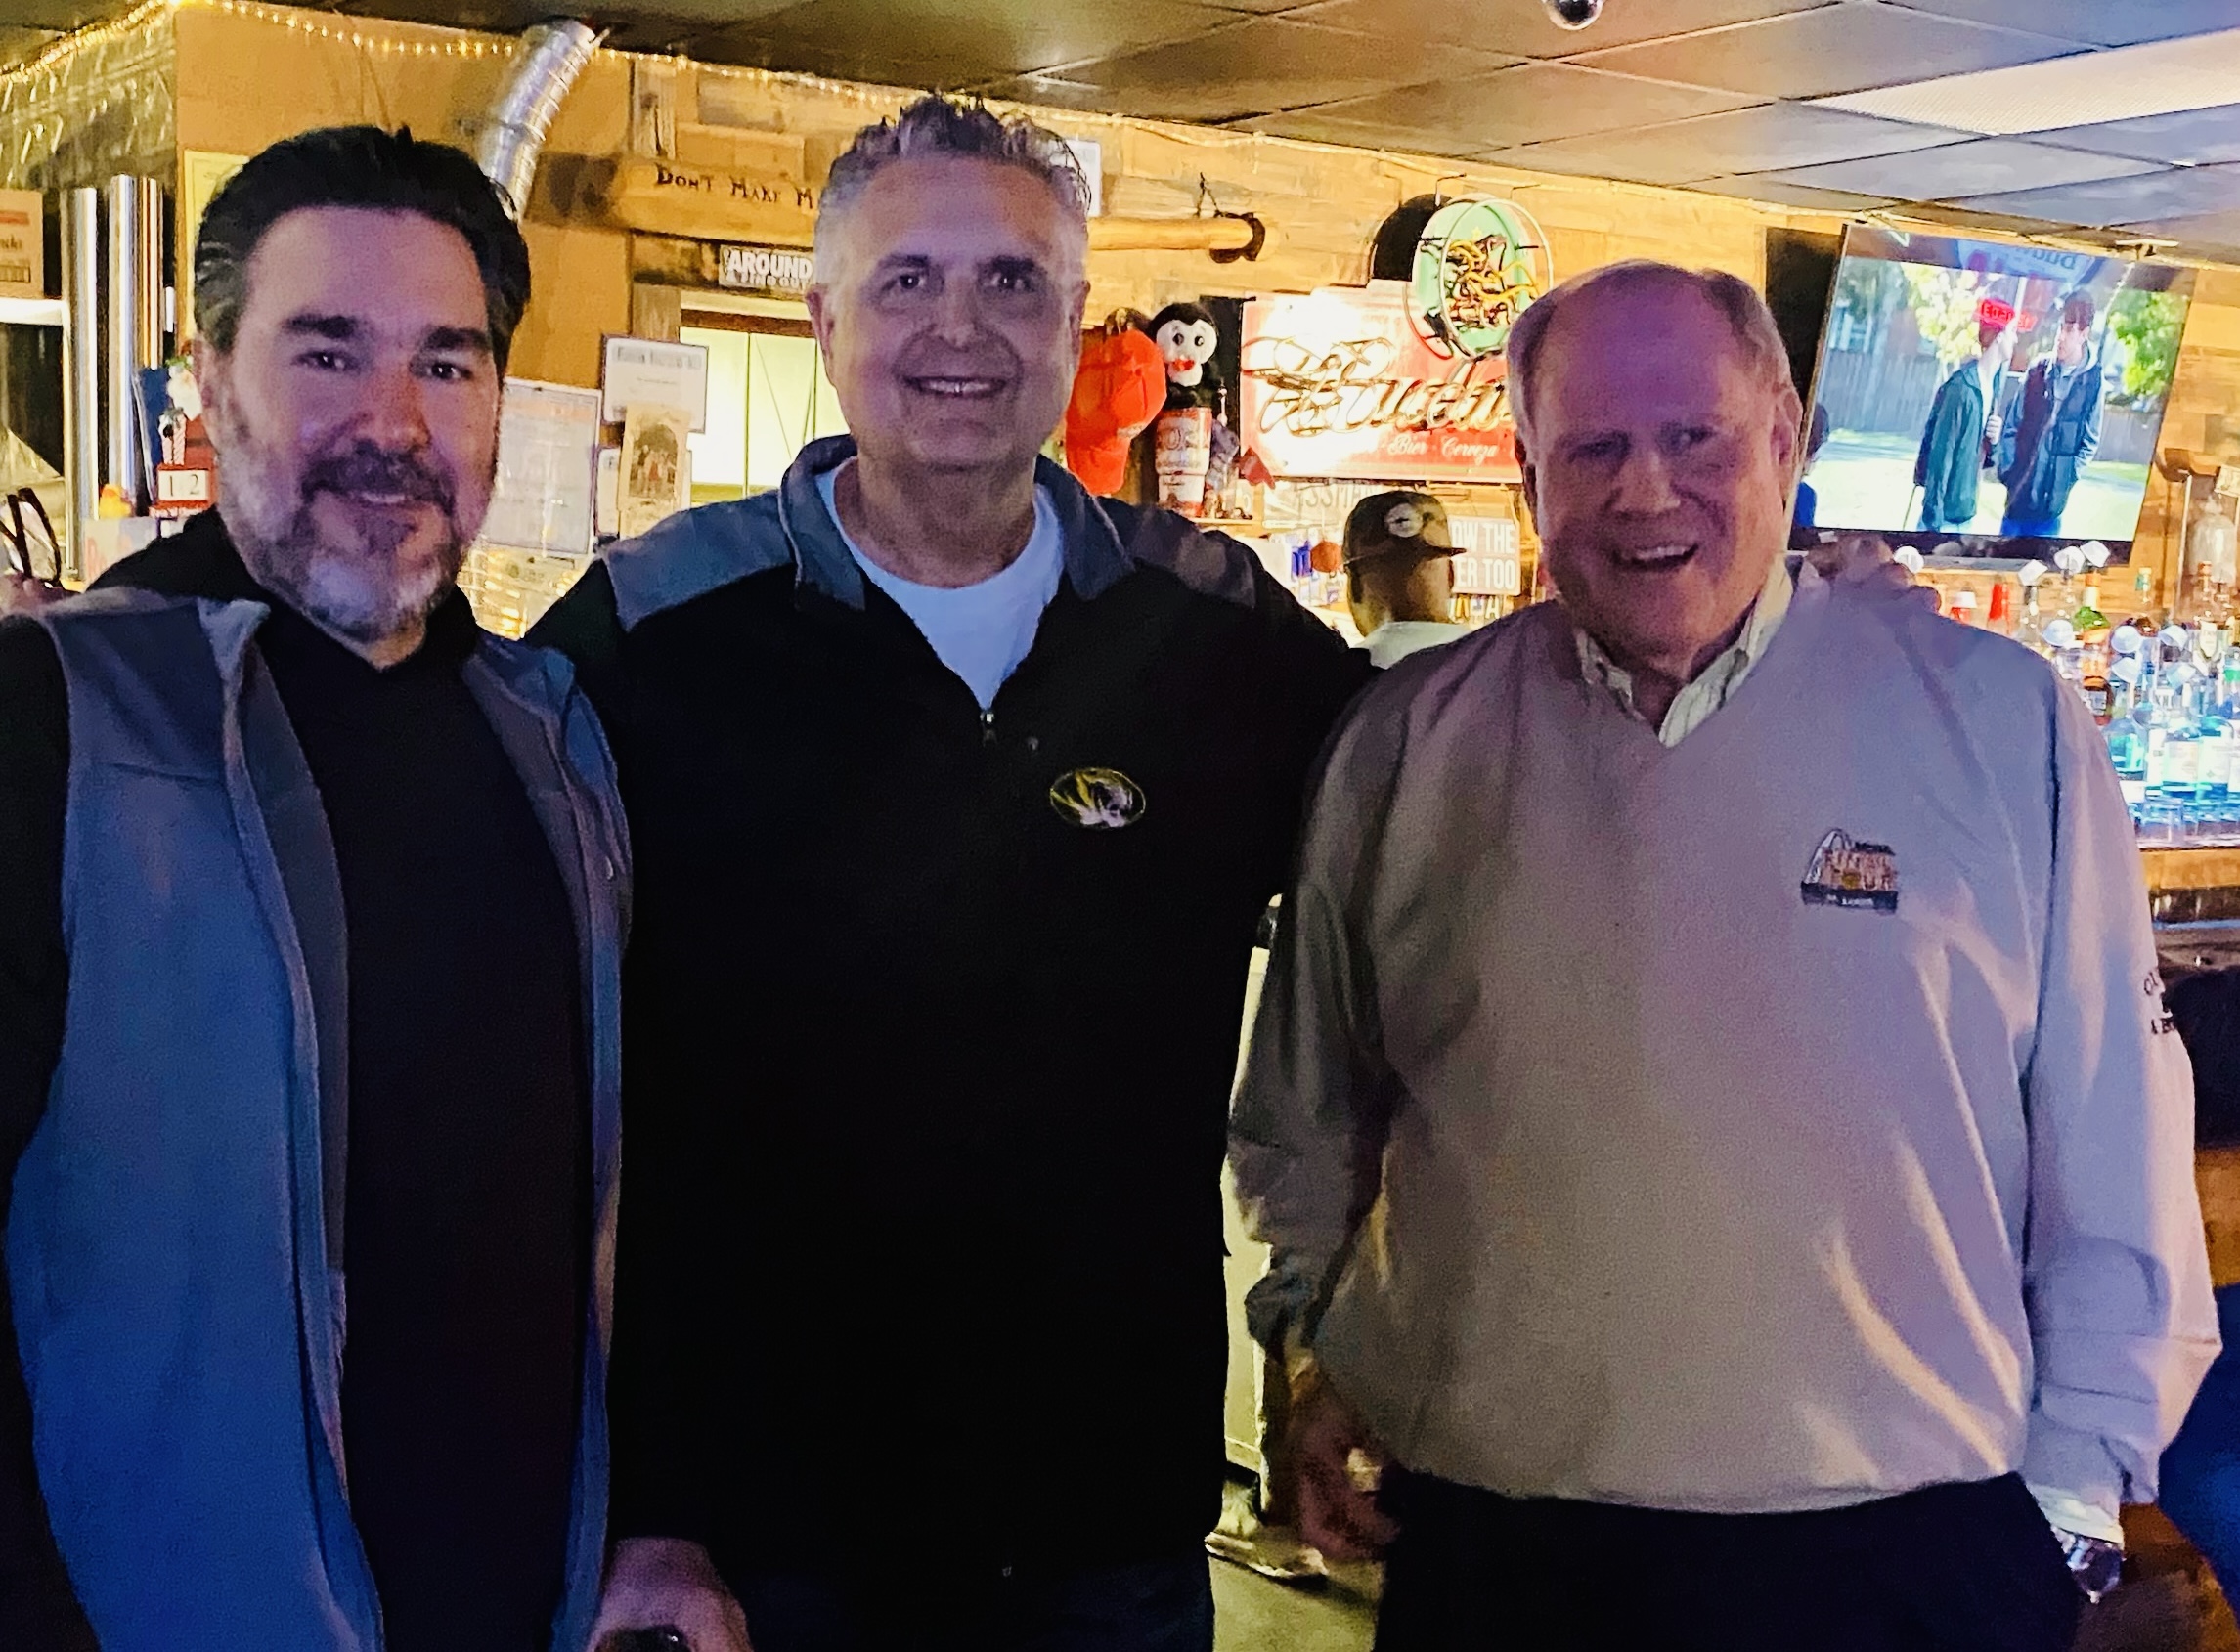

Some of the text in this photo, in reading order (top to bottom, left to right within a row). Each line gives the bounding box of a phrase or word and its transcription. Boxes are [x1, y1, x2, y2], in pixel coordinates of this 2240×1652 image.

[727, 249, 813, 280] AROUND
[1387, 433, 1428, 456] Bier
[1440, 437, 1500, 466] Cerveza
[1482, 523, 1516, 556] THE
[1482, 558, 1516, 590] TOO
